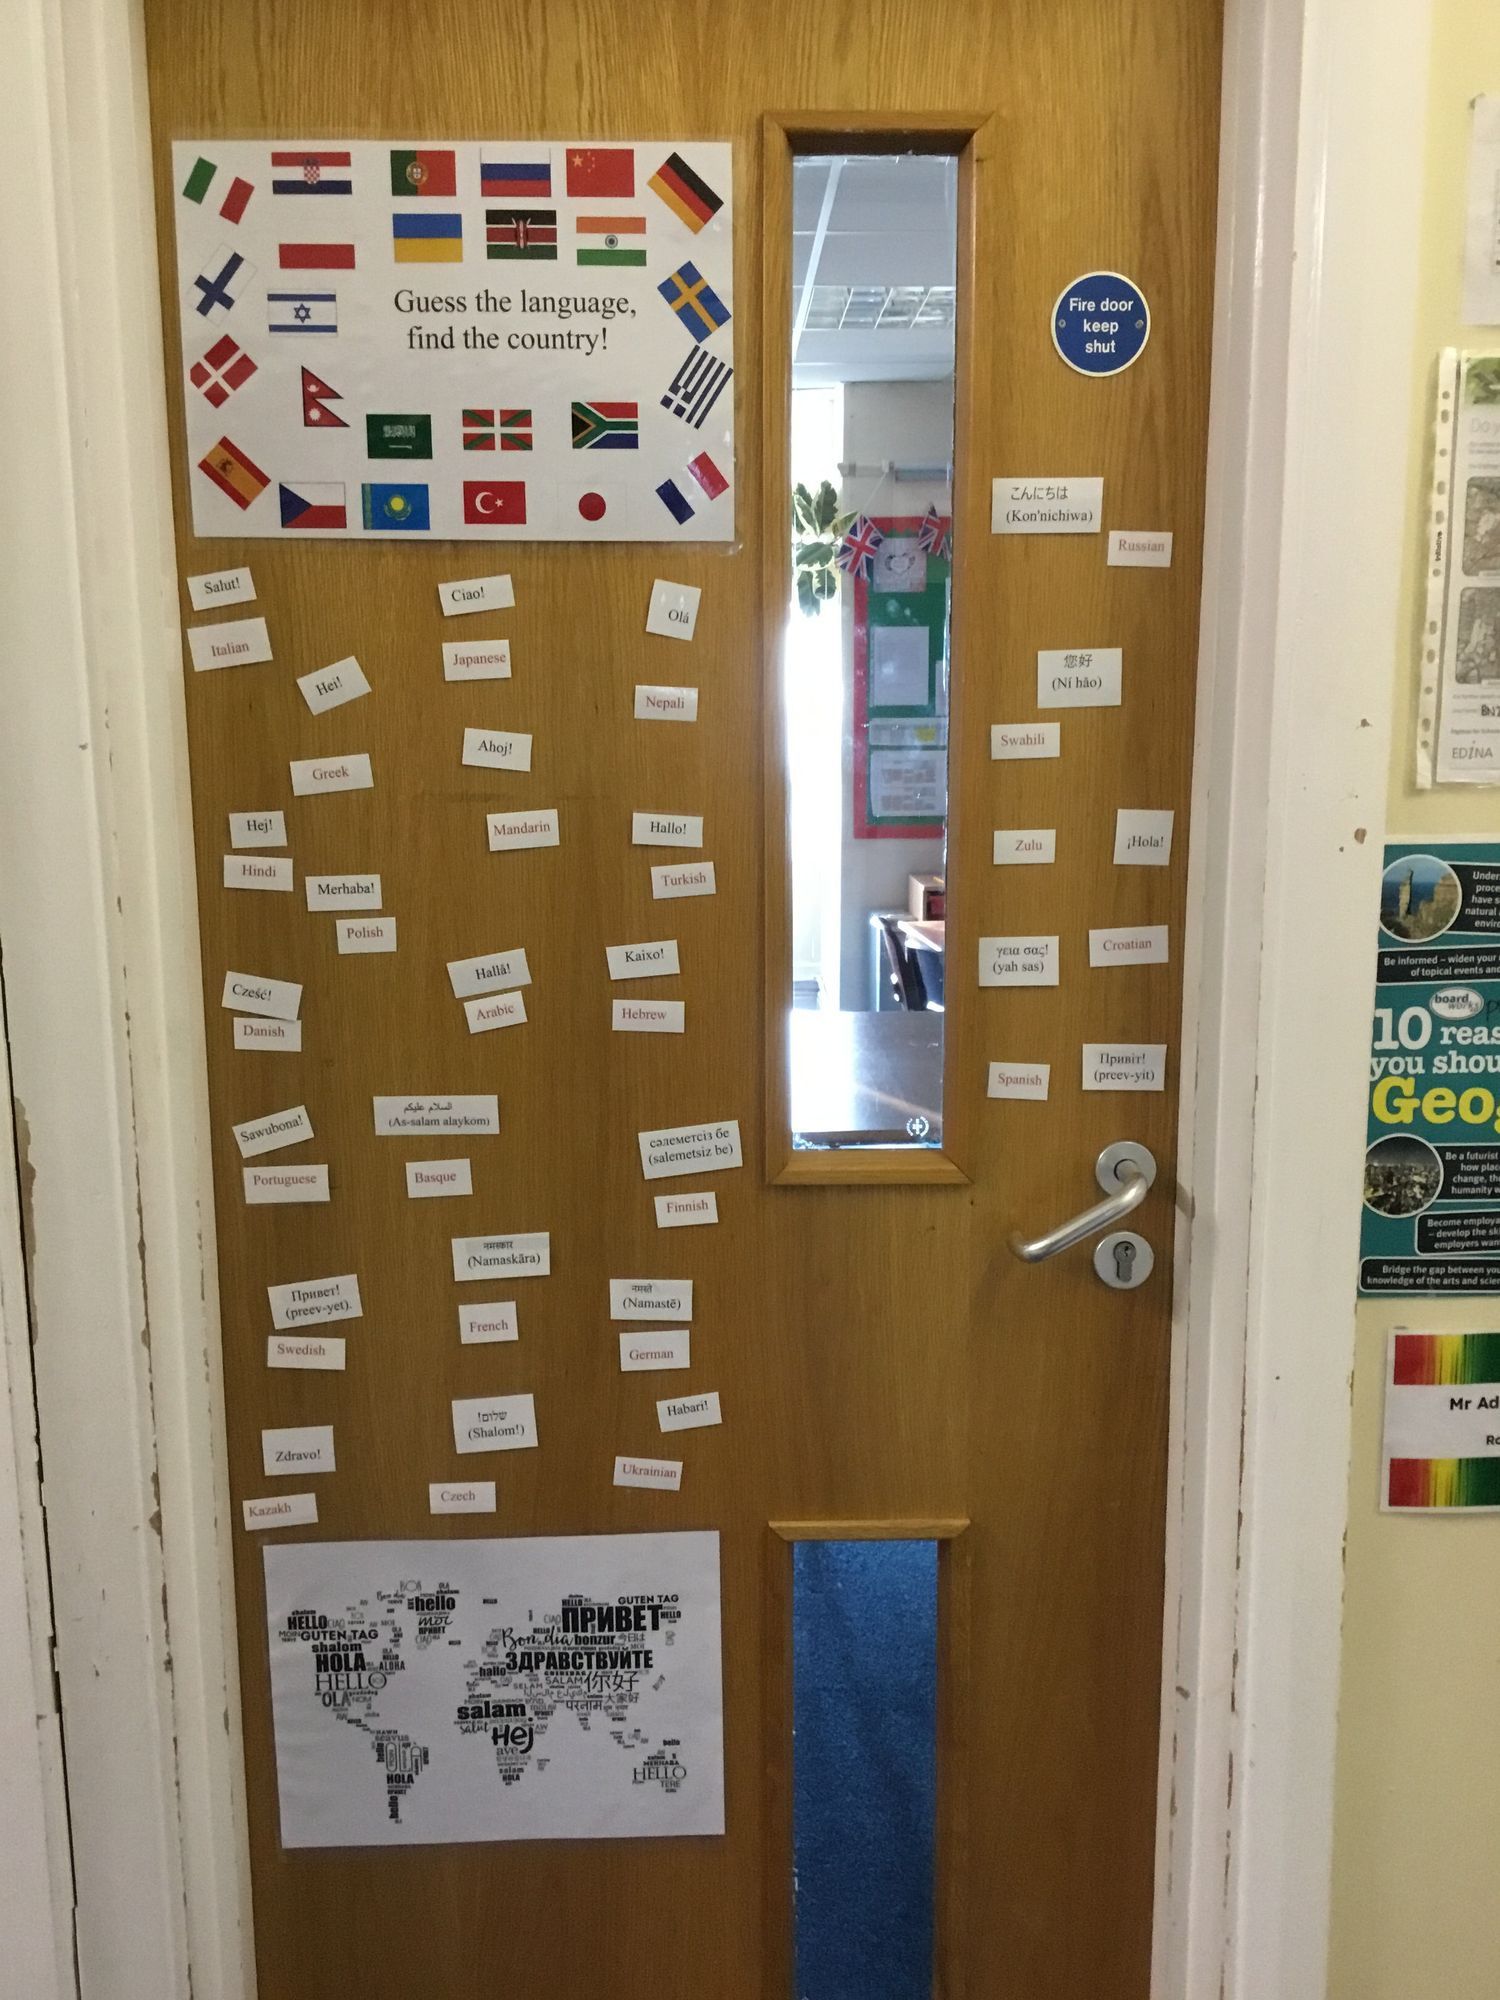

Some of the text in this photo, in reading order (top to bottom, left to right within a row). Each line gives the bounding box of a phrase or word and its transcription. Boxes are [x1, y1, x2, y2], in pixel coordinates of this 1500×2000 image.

[394, 289, 636, 319] Guess the language,
[1069, 297, 1134, 312] Fire door
[1083, 318, 1119, 335] keep
[408, 326, 607, 356] find the country!
[1085, 339, 1116, 354] shut
[1011, 485, 1069, 500] こんにちは
[1006, 509, 1093, 524] (Kon'nichiwa)
[1118, 538, 1165, 552] Russian
[204, 577, 240, 594] Salut!
[451, 587, 485, 602] Ciao!
[668, 609, 689, 624] Olá
[211, 642, 249, 657] Italian
[453, 654, 506, 667] Japanese
[1064, 654, 1093, 668] 您好
[315, 676, 343, 696] Hei!
[646, 696, 684, 711] Nepali
[1001, 733, 1045, 747] Swahili
[478, 740, 512, 757] Ahoj!
[313, 766, 349, 780] Greek
[247, 819, 272, 833] Hej!
[493, 820, 551, 836] Mandarin
[650, 821, 687, 834] Hallo!
[1015, 839, 1043, 852] Zulu
[1127, 835, 1164, 850] ¡Hola!
[242, 864, 276, 878] Hindi
[1473, 871, 1500, 880] Under
[661, 872, 706, 887] Turkish
[318, 883, 374, 895] Merhaba!
[1465, 907, 1496, 916] natural
[347, 926, 383, 940] Polish
[996, 944, 1048, 959] γεια σας!
[1103, 939, 1152, 951] Croatian
[625, 948, 664, 962] Kaixo!
[1384, 954, 1496, 966] Be informed widen your
[992, 961, 1044, 974] (yah sas)
[1411, 966, 1483, 977] of topical events
[232, 983, 272, 1001] Cześć!
[1435, 994, 1469, 1003] board
[476, 1004, 514, 1020] Arabic
[622, 1007, 667, 1020] Hebrew
[243, 1025, 285, 1038] Danish
[1373, 1006, 1432, 1050] 10
[1100, 1052, 1146, 1066] Привіт!
[1370, 1056, 1425, 1081] you
[998, 1073, 1042, 1087] Spanish
[1094, 1069, 1155, 1083] (preev-yit)
[1373, 1076, 1500, 1133] Geo
[240, 1115, 303, 1142] Sawubona!
[389, 1116, 490, 1128] (As-salam alaykom)
[650, 1128, 729, 1148] сәлеметсіз бе
[649, 1144, 733, 1166] (salemetsiz be)
[1446, 1152, 1457, 1160] Be
[1467, 1151, 1498, 1160] futurist
[1461, 1162, 1479, 1171] how
[253, 1174, 317, 1187] Portuguese
[415, 1172, 456, 1184] Basque
[1451, 1186, 1492, 1195] humanity
[667, 1200, 708, 1213] Finnish
[1428, 1219, 1461, 1227] Become
[1436, 1228, 1487, 1238] develop the
[1434, 1240, 1479, 1250] employers
[1382, 1265, 1411, 1275] Bridge
[1413, 1265, 1427, 1273] the
[1429, 1266, 1445, 1275] gap
[1448, 1265, 1484, 1274] between
[1367, 1275, 1478, 1286] knowledge of the arts and
[292, 1284, 340, 1302] Привет!
[470, 1319, 508, 1332] French
[277, 1343, 325, 1355] Swedish
[629, 1349, 673, 1360] German
[667, 1400, 709, 1416] Habari!
[1450, 1395, 1499, 1410] Mr Ad
[468, 1424, 525, 1440] (Shalom!)
[275, 1449, 320, 1462] Zdravo!
[623, 1463, 677, 1478] Ukrainian
[441, 1490, 475, 1502] Czech
[249, 1503, 292, 1517] Kazakh
[415, 1595, 456, 1612] hello
[618, 1594, 679, 1605] GUTEN TAG
[562, 1604, 662, 1633] ПРИВЕТ
[660, 1611, 681, 1619] HELLO
[287, 1615, 327, 1630] HELLO
[301, 1629, 378, 1641] GUTEN TAG
[502, 1625, 575, 1651] Bon dia
[574, 1635, 616, 1645] bonzur
[311, 1642, 362, 1653] shalom
[316, 1653, 366, 1673] HOLA
[379, 1661, 405, 1671] ALOHA
[505, 1647, 653, 1673] ЗДРАВСТВУЙТЕ
[480, 1667, 506, 1676] hallo
[315, 1671, 387, 1692] HELLO
[545, 1677, 583, 1685] SALAM
[583, 1671, 639, 1694] 你好
[322, 1691, 350, 1707] OLA
[457, 1700, 526, 1720] salam
[491, 1717, 534, 1754] Hej
[386, 1774, 414, 1784] HOLA
[633, 1765, 687, 1780] HELLO
